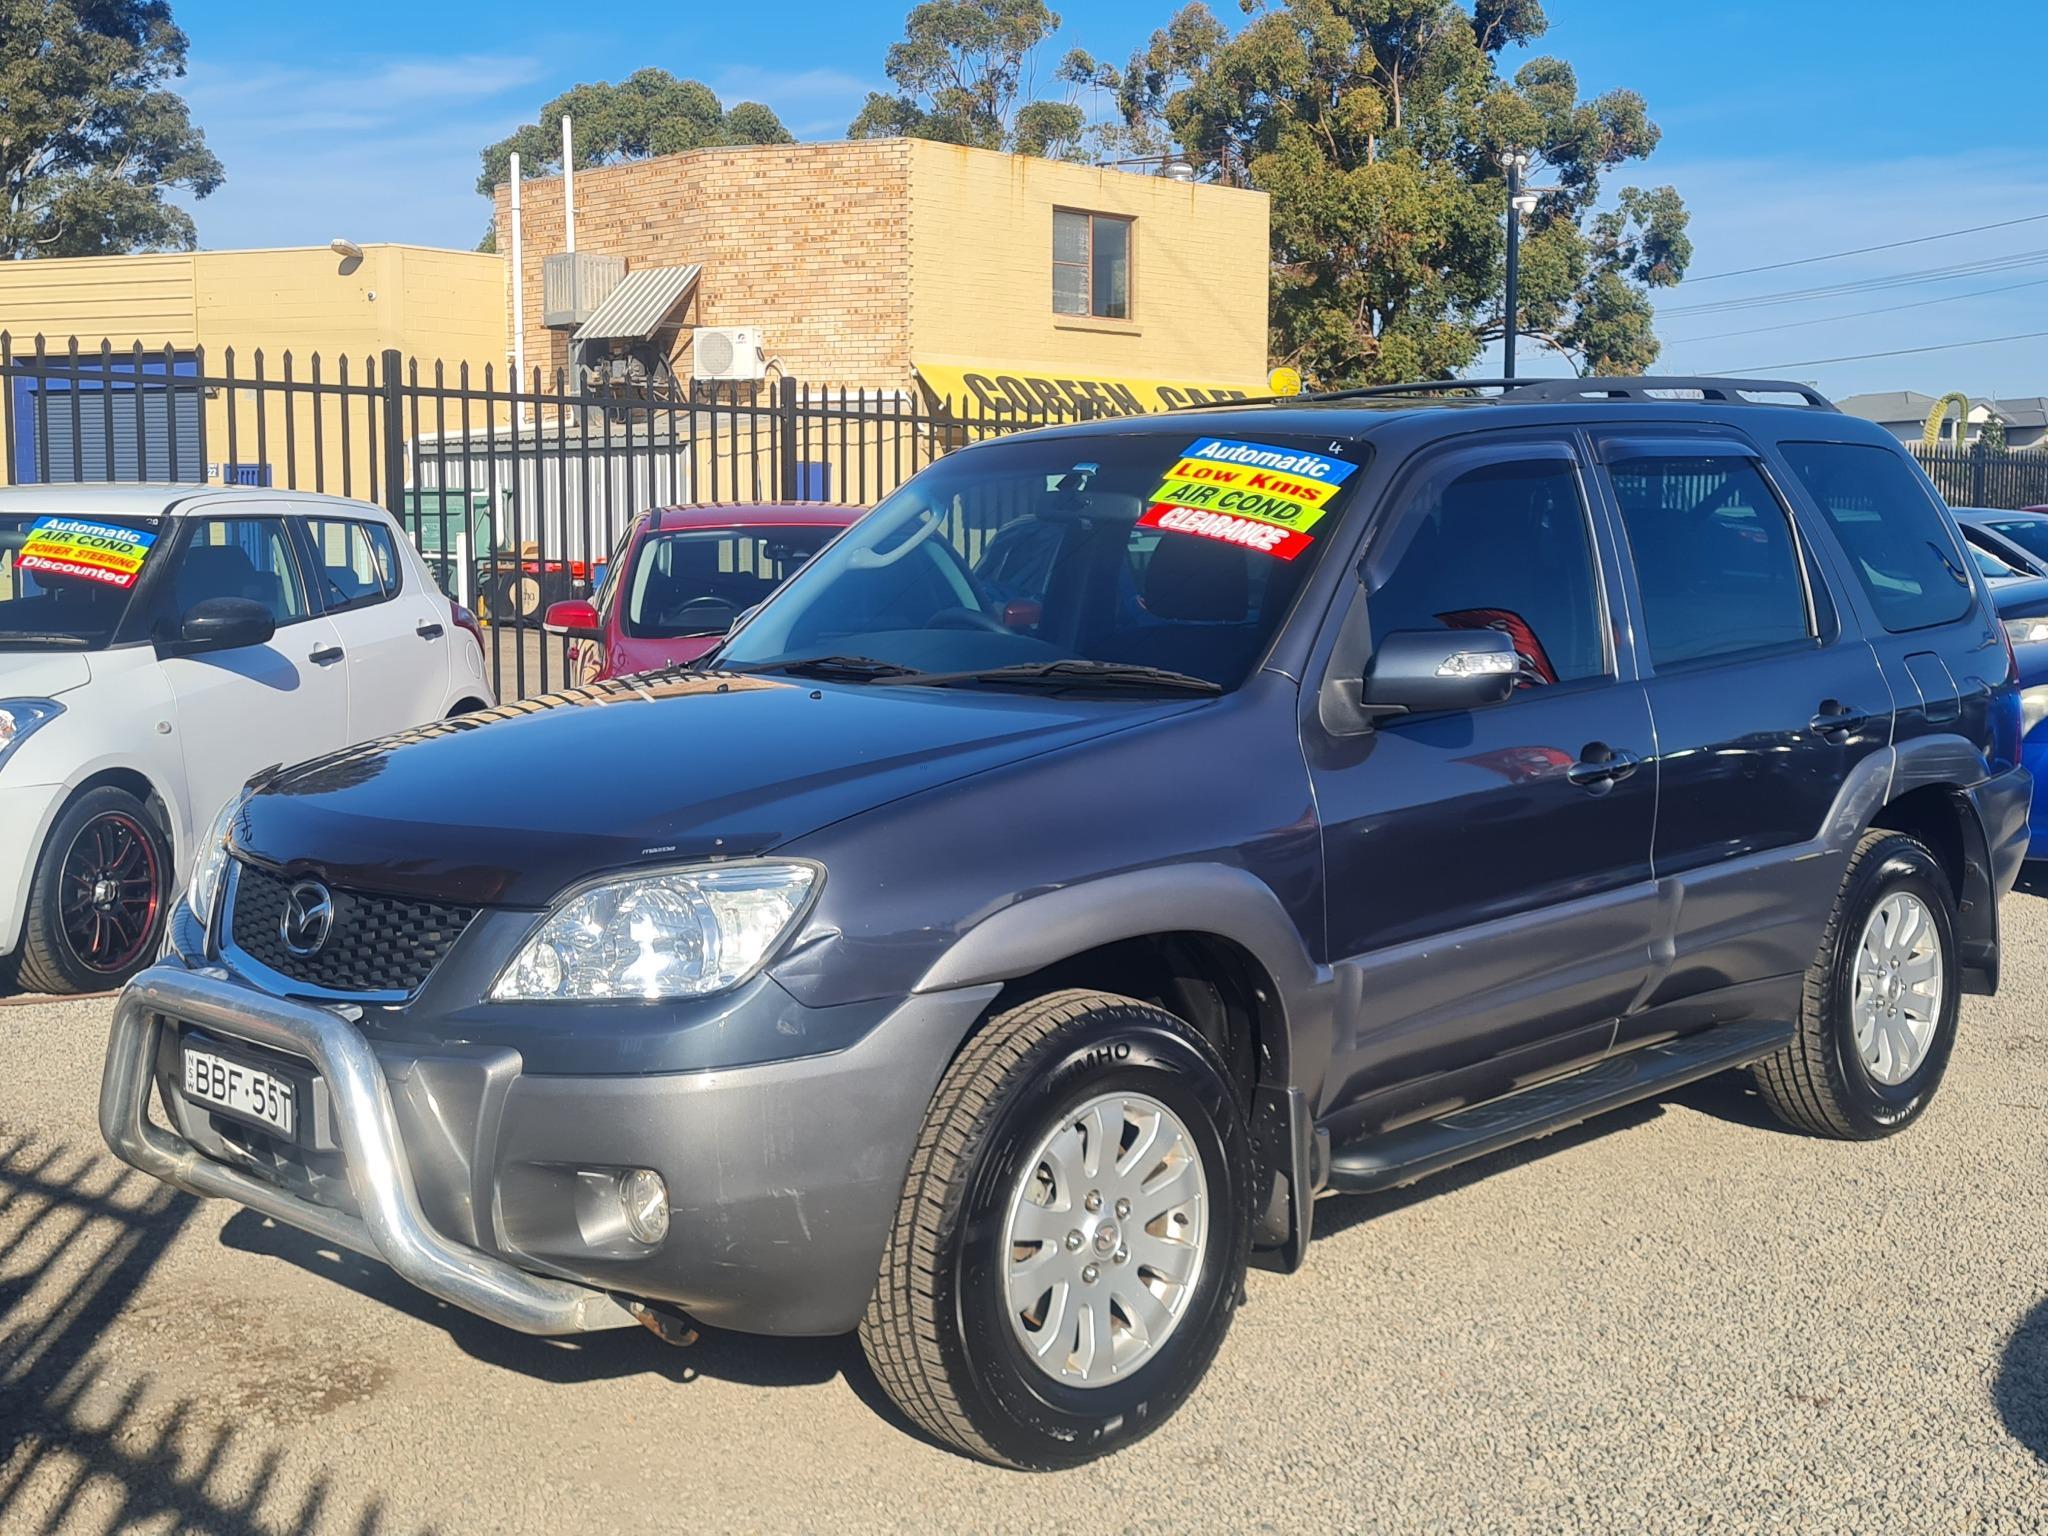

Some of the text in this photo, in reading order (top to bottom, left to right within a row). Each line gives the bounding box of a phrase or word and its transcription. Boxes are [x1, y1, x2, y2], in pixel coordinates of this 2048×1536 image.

[1195, 441, 1330, 478] Automatic
[1328, 440, 1344, 455] 4
[1175, 462, 1322, 501] Low Kms
[1165, 483, 1304, 525] AIR COND.
[36, 530, 134, 556] AIR COND.
[43, 518, 141, 543] Automatic
[1158, 507, 1290, 551] CLEARANCE
[21, 556, 130, 585] Discounted
[26, 543, 137, 569] POWER STEERING
